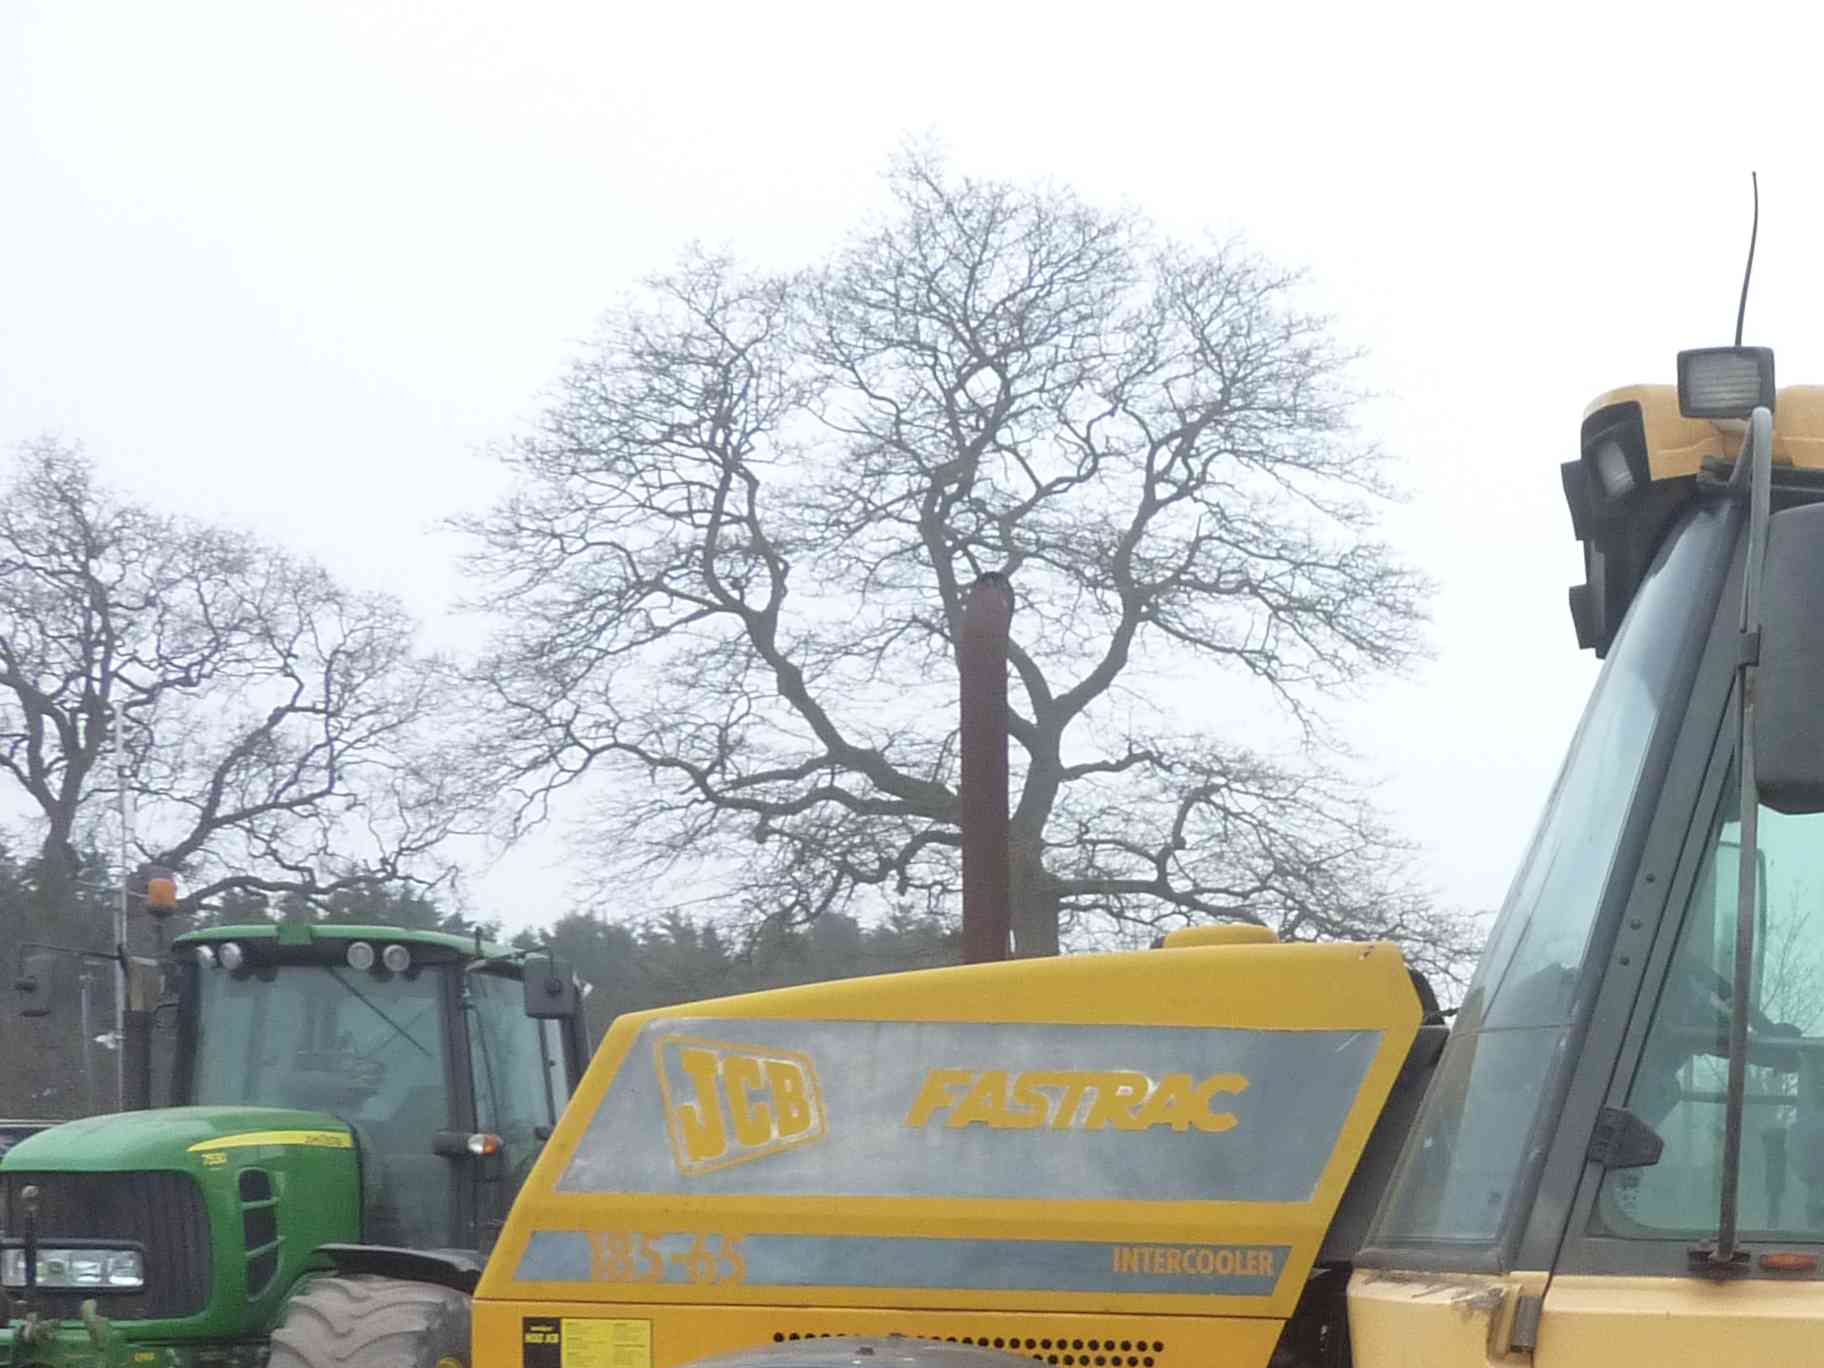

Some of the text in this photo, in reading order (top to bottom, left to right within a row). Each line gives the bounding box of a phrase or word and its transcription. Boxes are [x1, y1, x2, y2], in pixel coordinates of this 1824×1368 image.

[677, 1050, 813, 1162] JCB
[905, 1068, 1249, 1133] FASTRAC
[1112, 1246, 1276, 1275] INTERCOOLER
